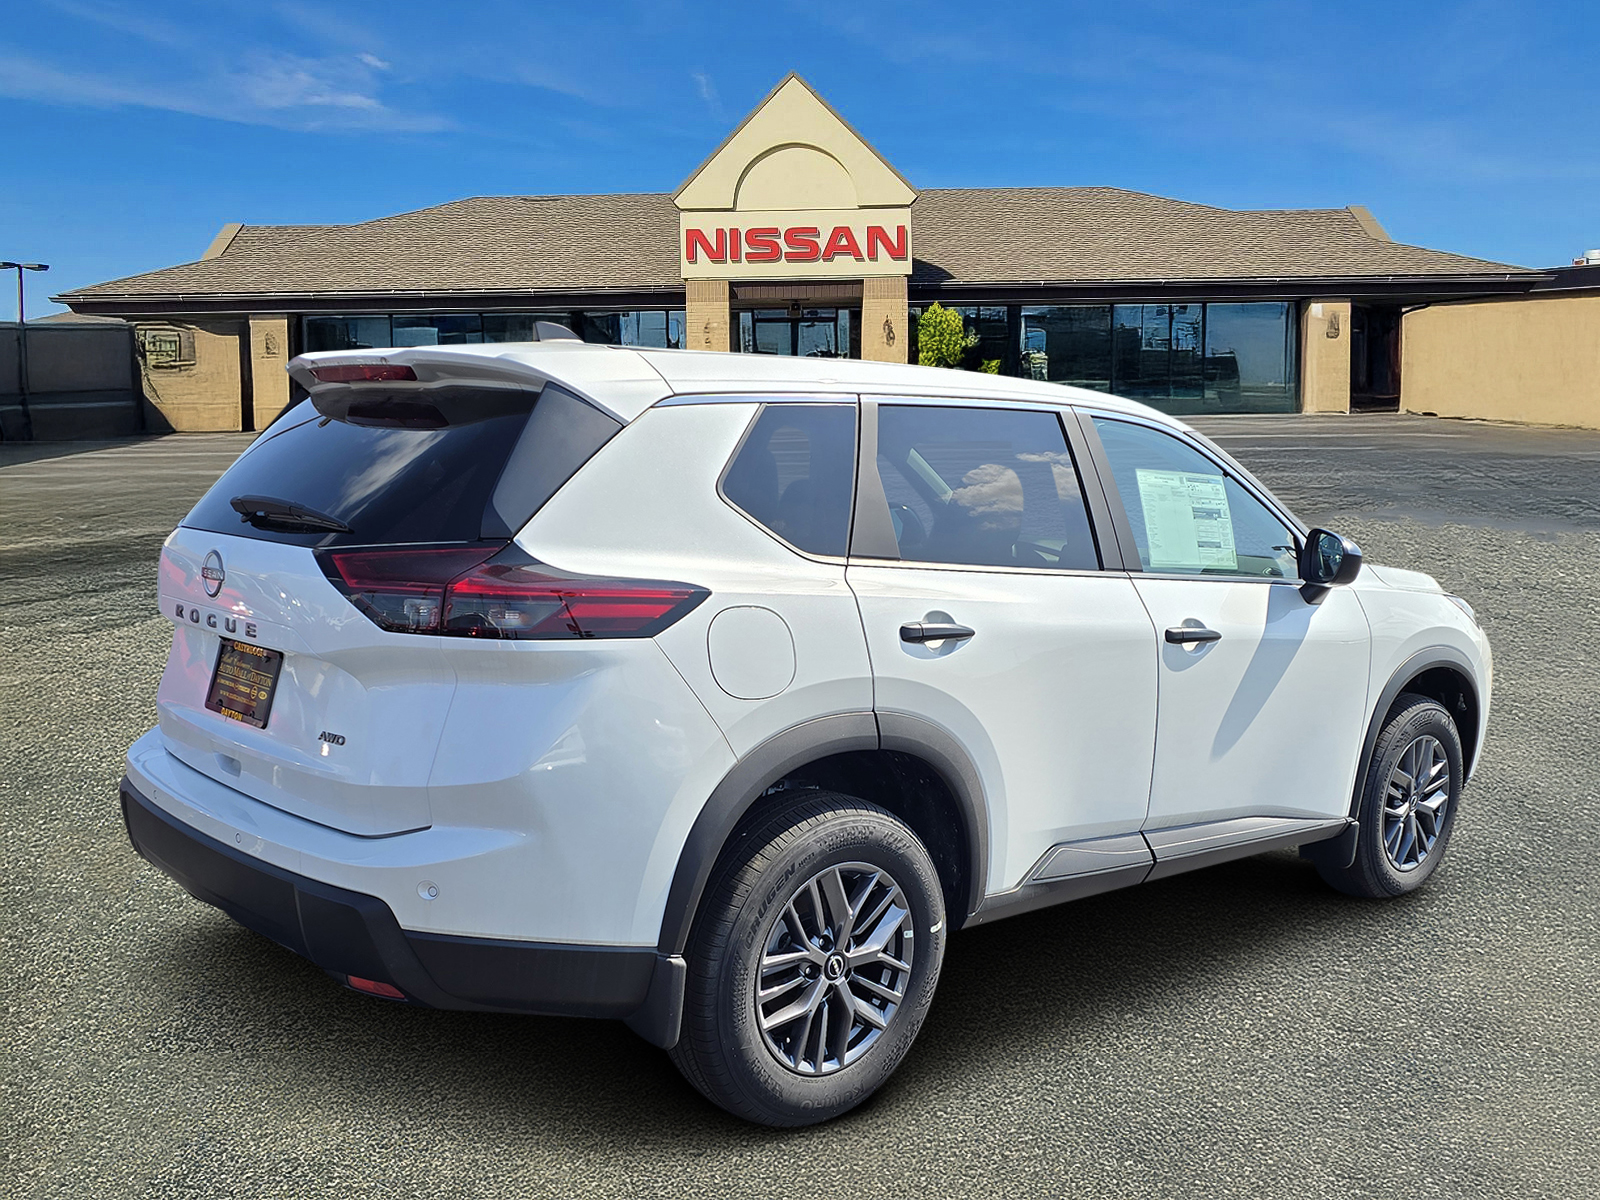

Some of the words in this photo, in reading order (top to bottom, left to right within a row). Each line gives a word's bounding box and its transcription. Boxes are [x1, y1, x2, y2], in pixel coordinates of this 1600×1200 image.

[686, 225, 908, 264] NISSAN
[203, 568, 224, 580] SSAN
[175, 604, 258, 639] ROGUE
[220, 707, 243, 721] DAYTON
[318, 731, 346, 746] AWD
[745, 862, 796, 950] CRUGEN
[799, 1079, 865, 1112] KUMHO
